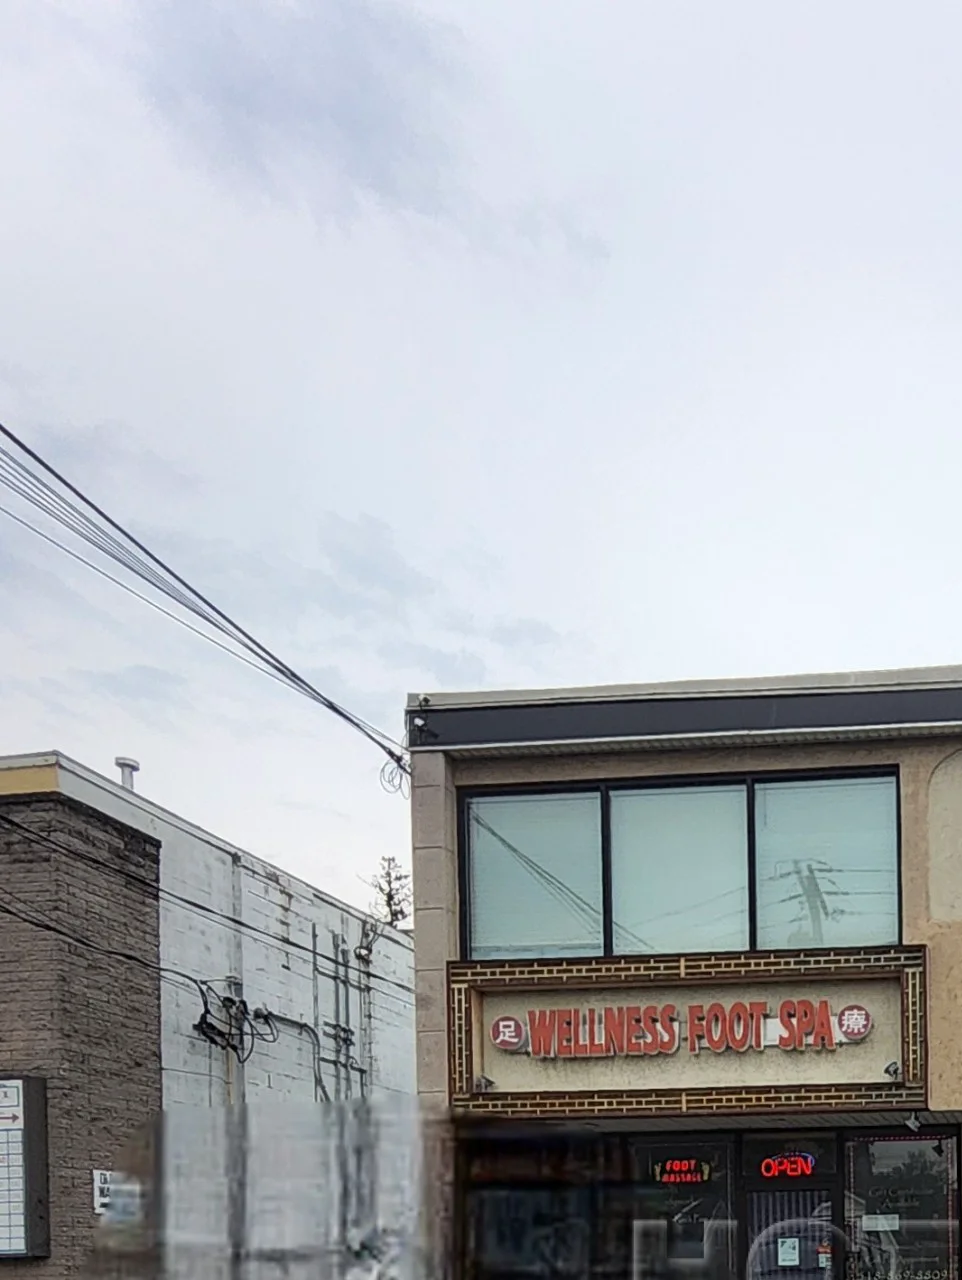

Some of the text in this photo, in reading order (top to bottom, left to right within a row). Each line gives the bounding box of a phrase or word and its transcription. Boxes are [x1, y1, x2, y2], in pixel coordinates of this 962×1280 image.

[494, 1018, 520, 1045] 足
[528, 998, 838, 1058] WELLNESS FOOT SPA
[664, 1158, 698, 1172] FOOT
[761, 1157, 812, 1177] OPEN
